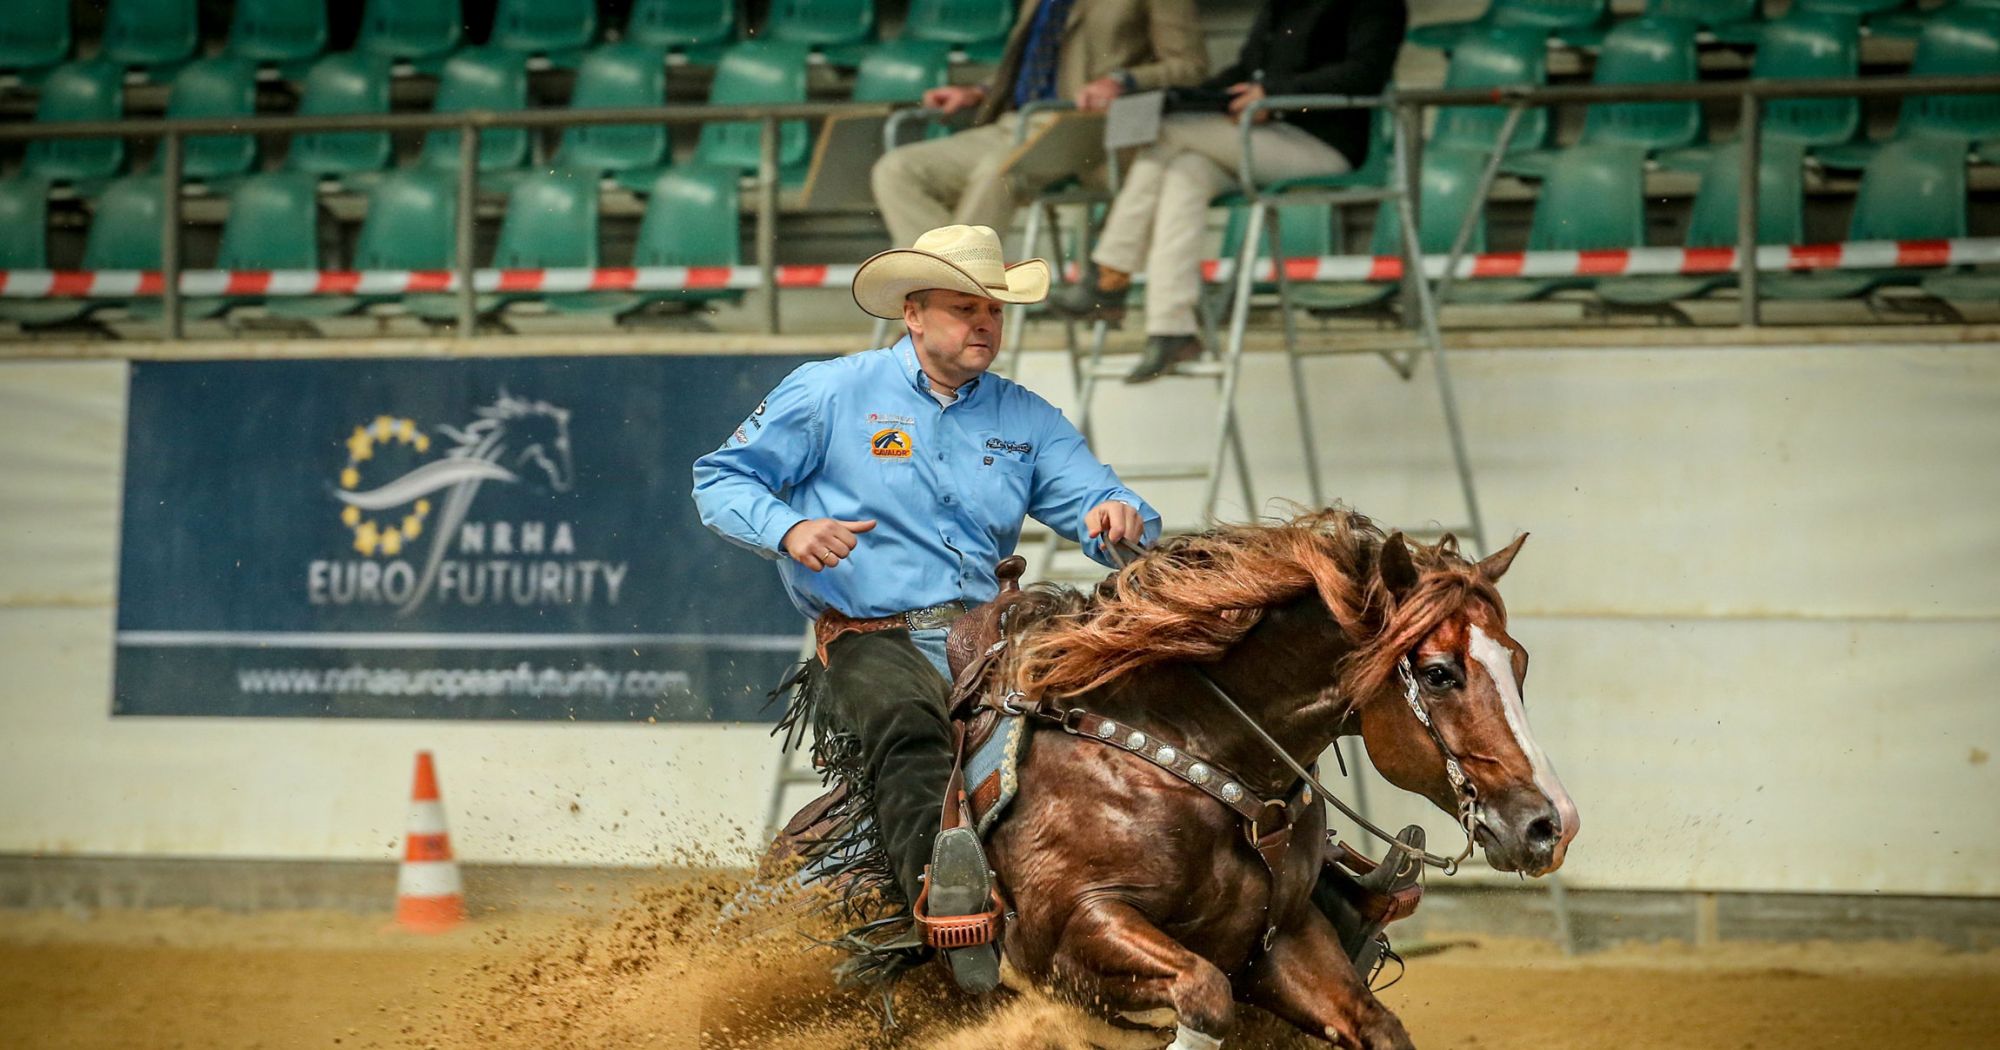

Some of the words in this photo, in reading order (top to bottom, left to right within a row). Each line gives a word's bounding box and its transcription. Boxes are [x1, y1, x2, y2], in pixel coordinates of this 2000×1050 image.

[873, 449, 908, 457] CAVALOR
[460, 520, 575, 555] NRHA
[308, 559, 415, 604] EURO
[438, 560, 628, 605] FUTURITY
[238, 662, 690, 702] www.nrhaeuropeanfuturity.com
